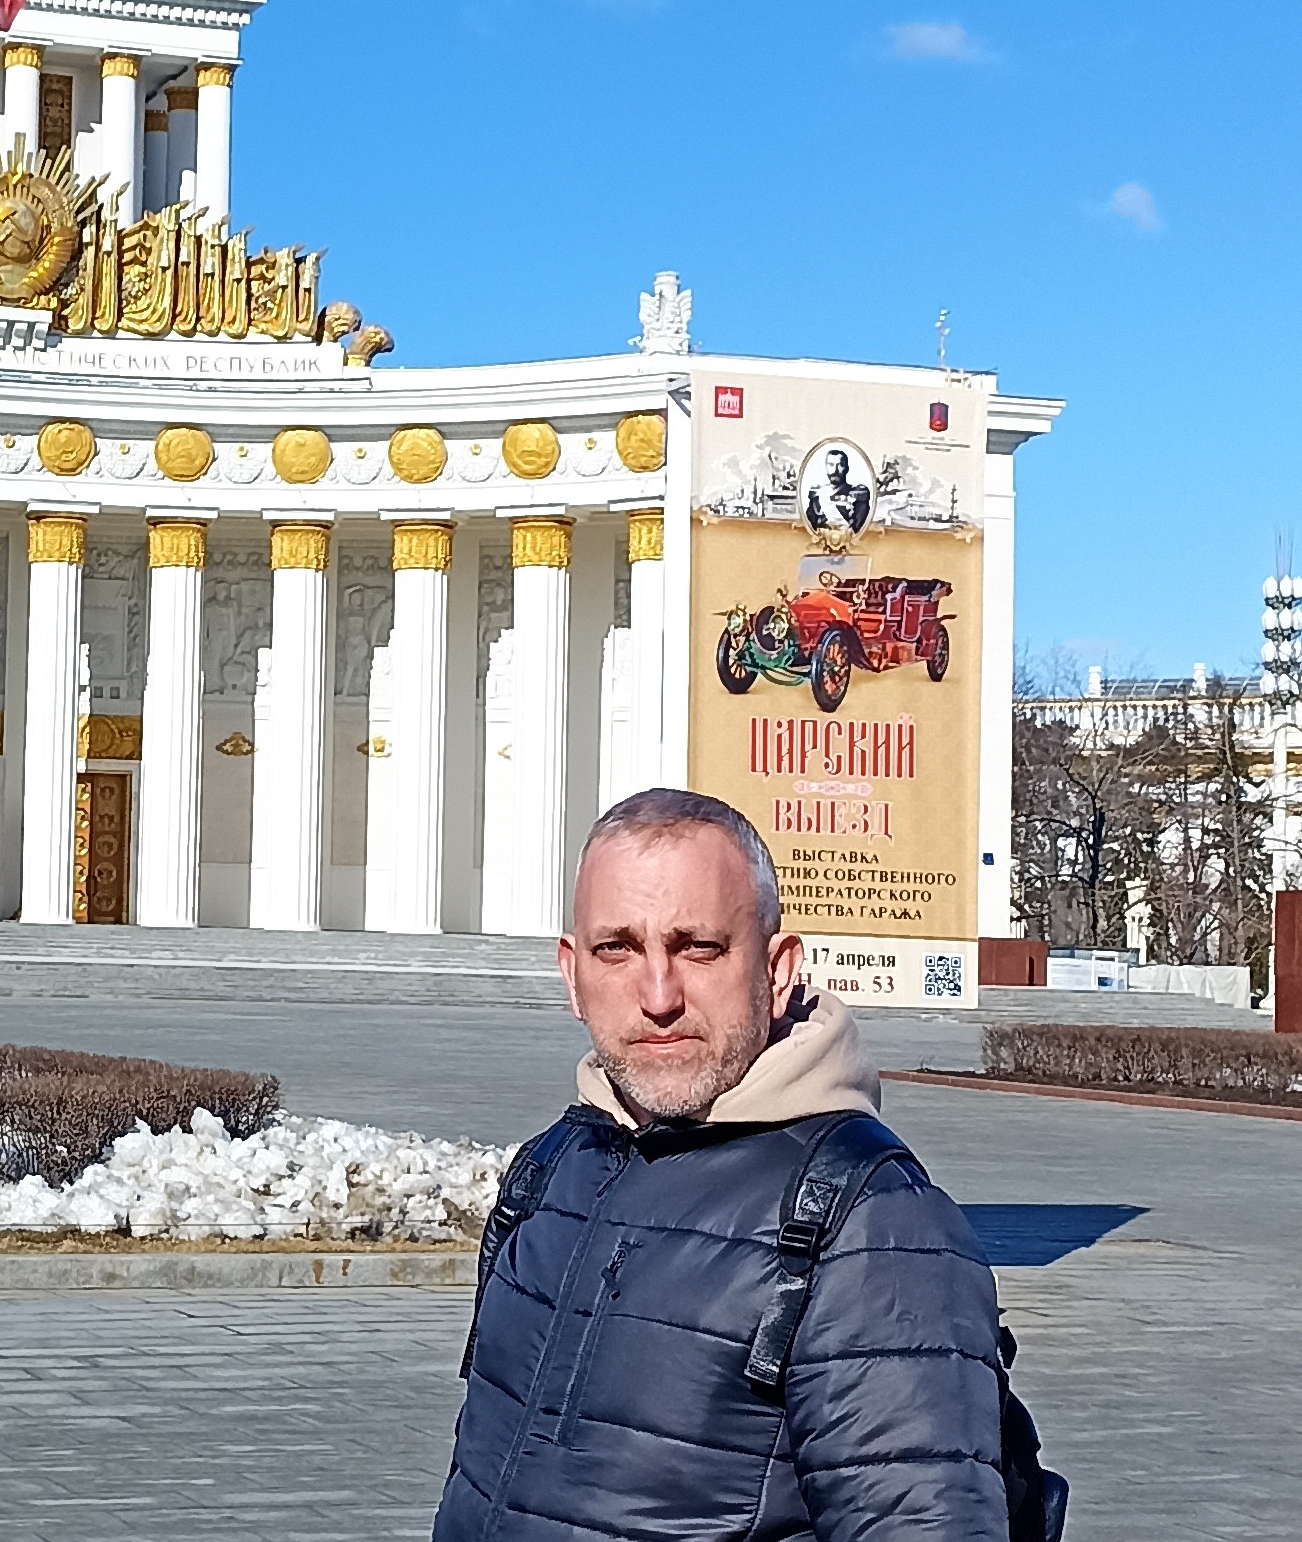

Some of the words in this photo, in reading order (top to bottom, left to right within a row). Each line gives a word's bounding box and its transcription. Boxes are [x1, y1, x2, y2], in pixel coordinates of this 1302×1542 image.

[186, 356, 322, 373] РЕСПУБЛИК
[749, 713, 916, 780] ЦАРСКИЙ
[773, 797, 894, 845] ВЫЕЗД
[792, 849, 880, 864] ВЫСТАВКА
[823, 868, 957, 886] СОБСТВЕННОГО
[860, 906, 923, 920] ГАРАЖА
[836, 952, 896, 970] апреля
[827, 977, 866, 993] пав.
[872, 976, 895, 994] 53
